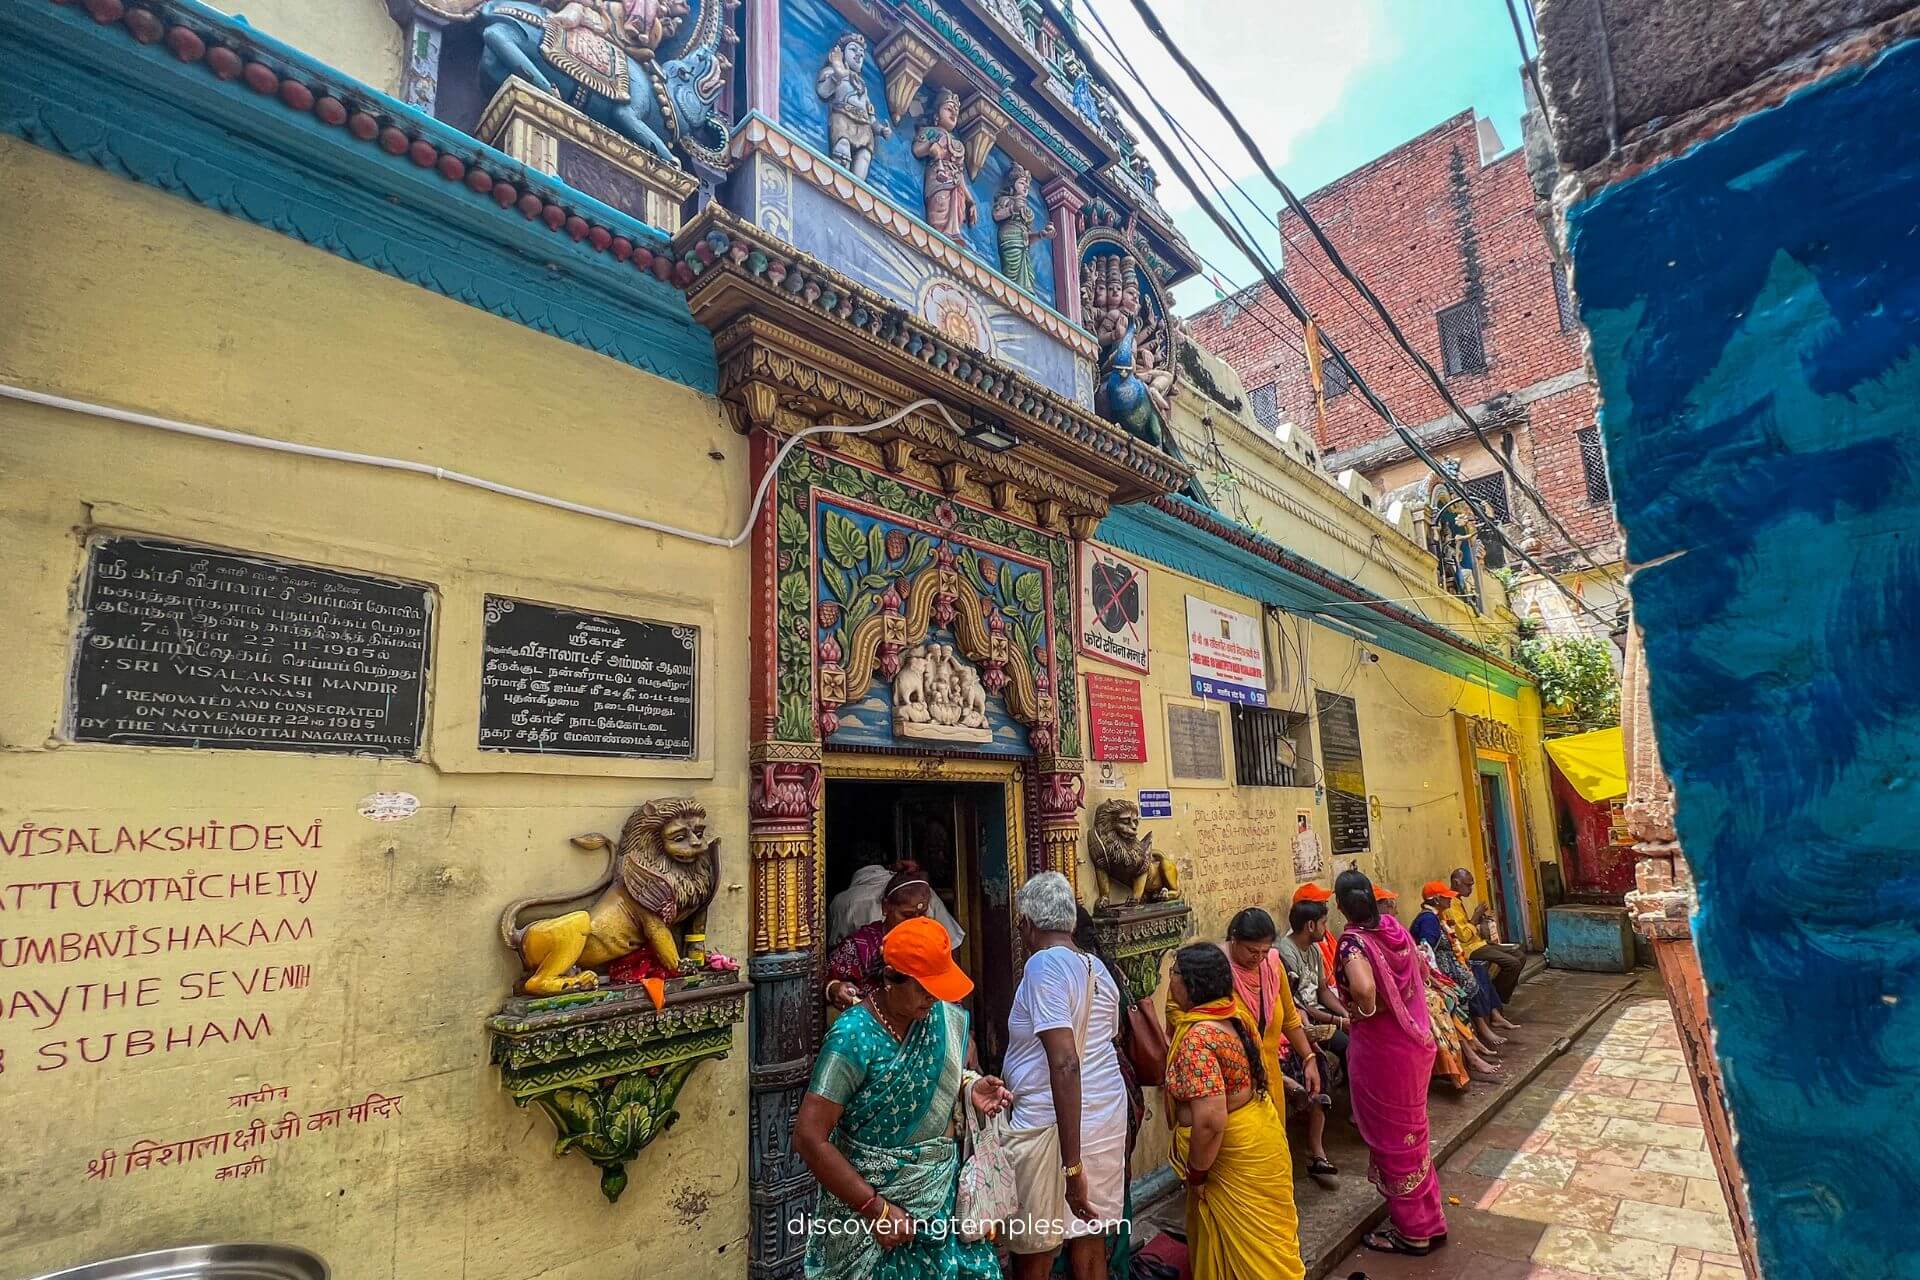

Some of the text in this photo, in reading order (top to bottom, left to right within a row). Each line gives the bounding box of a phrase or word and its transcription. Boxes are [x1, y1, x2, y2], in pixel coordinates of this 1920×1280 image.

[99, 560, 127, 580] ஸ்ரீ
[132, 568, 183, 584] காசி
[299, 593, 363, 611] அம்மன்
[366, 600, 421, 619] கோவில்
[1084, 630, 1102, 649] फोटो
[1103, 636, 1126, 659] खींचना
[117, 658, 398, 694] SRI VISALAKSHI MANDIR
[607, 655, 653, 671] அம்மன்
[125, 690, 384, 718] RENOVATED AND CONSECRATED
[220, 684, 312, 698] VARANASI
[81, 717, 109, 728] BY
[116, 719, 155, 731] THE
[302, 730, 411, 744] NAGARATHARS
[136, 706, 164, 716] ON
[173, 708, 281, 724] NOVEMBER
[329, 717, 376, 729] 1985
[569, 717, 667, 732] நாட்டுக்கோட்டை
[481, 728, 512, 740] நகர
[180, 964, 310, 1000] SEVENTH
[37, 1013, 271, 1071] SUBHAM
[85, 1148, 117, 1181] श्री
[271, 1111, 302, 1139] जी
[307, 1109, 343, 1132] का
[347, 1093, 403, 1124] मन्दिर
[214, 1156, 270, 1183] काशी
